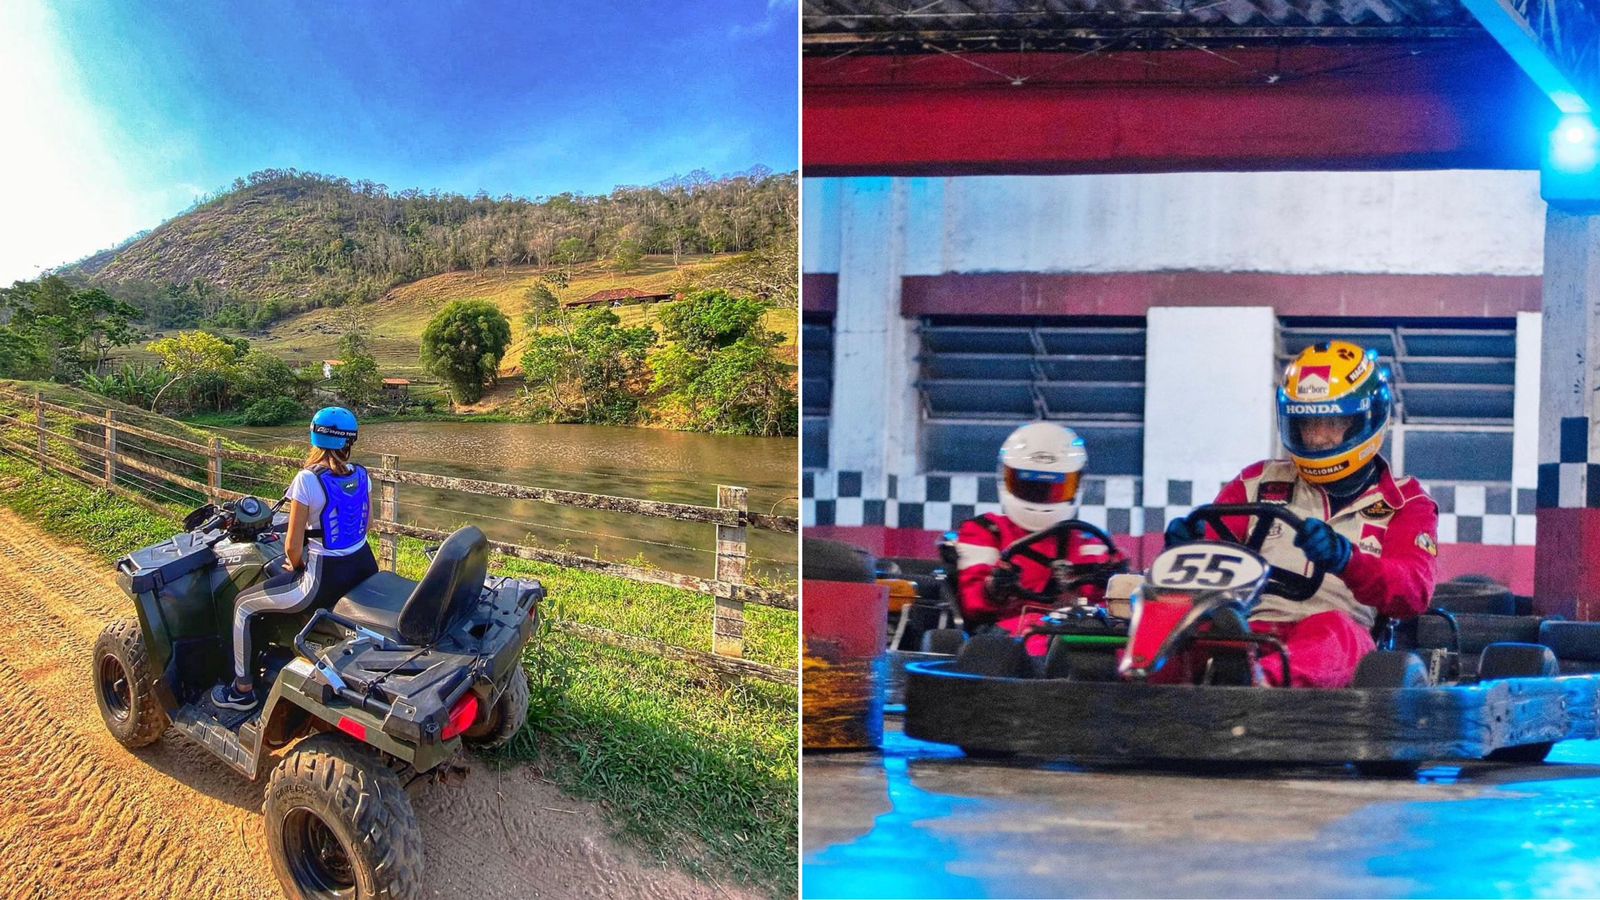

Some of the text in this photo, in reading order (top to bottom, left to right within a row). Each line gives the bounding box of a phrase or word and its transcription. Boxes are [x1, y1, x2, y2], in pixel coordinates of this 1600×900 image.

[1286, 404, 1343, 415] HONDA
[1303, 464, 1345, 475] NACIONAL
[1161, 553, 1243, 587] 55
